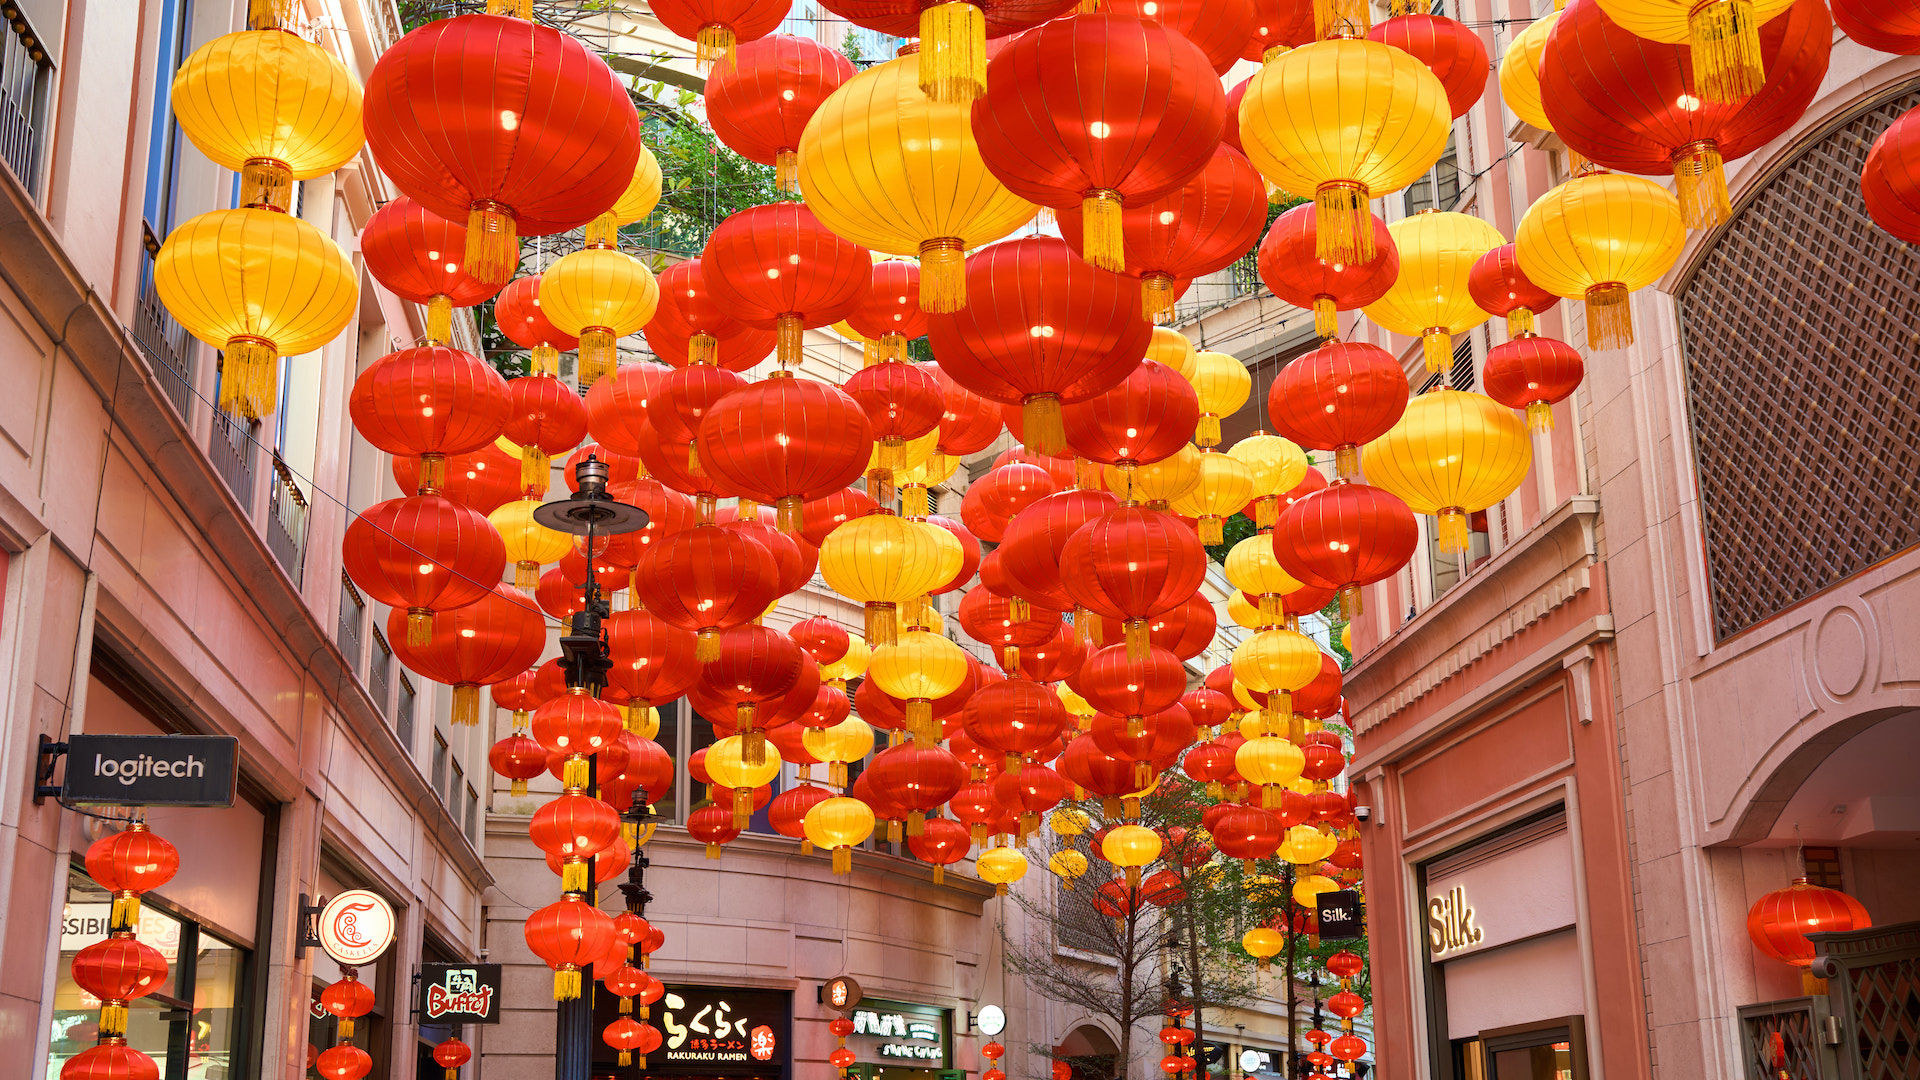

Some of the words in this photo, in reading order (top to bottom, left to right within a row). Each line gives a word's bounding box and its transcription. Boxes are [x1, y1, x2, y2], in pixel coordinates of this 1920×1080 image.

[94, 753, 204, 785] logitech
[1322, 908, 1352, 923] Silk.
[1428, 887, 1482, 954] Silk.
[427, 983, 494, 1018] Buffet
[663, 992, 748, 1050] らくらく
[667, 1051, 715, 1060] RAKURAKU
[717, 1053, 747, 1061] RAMEN
[690, 1038, 745, 1051] 博多ラーメン
